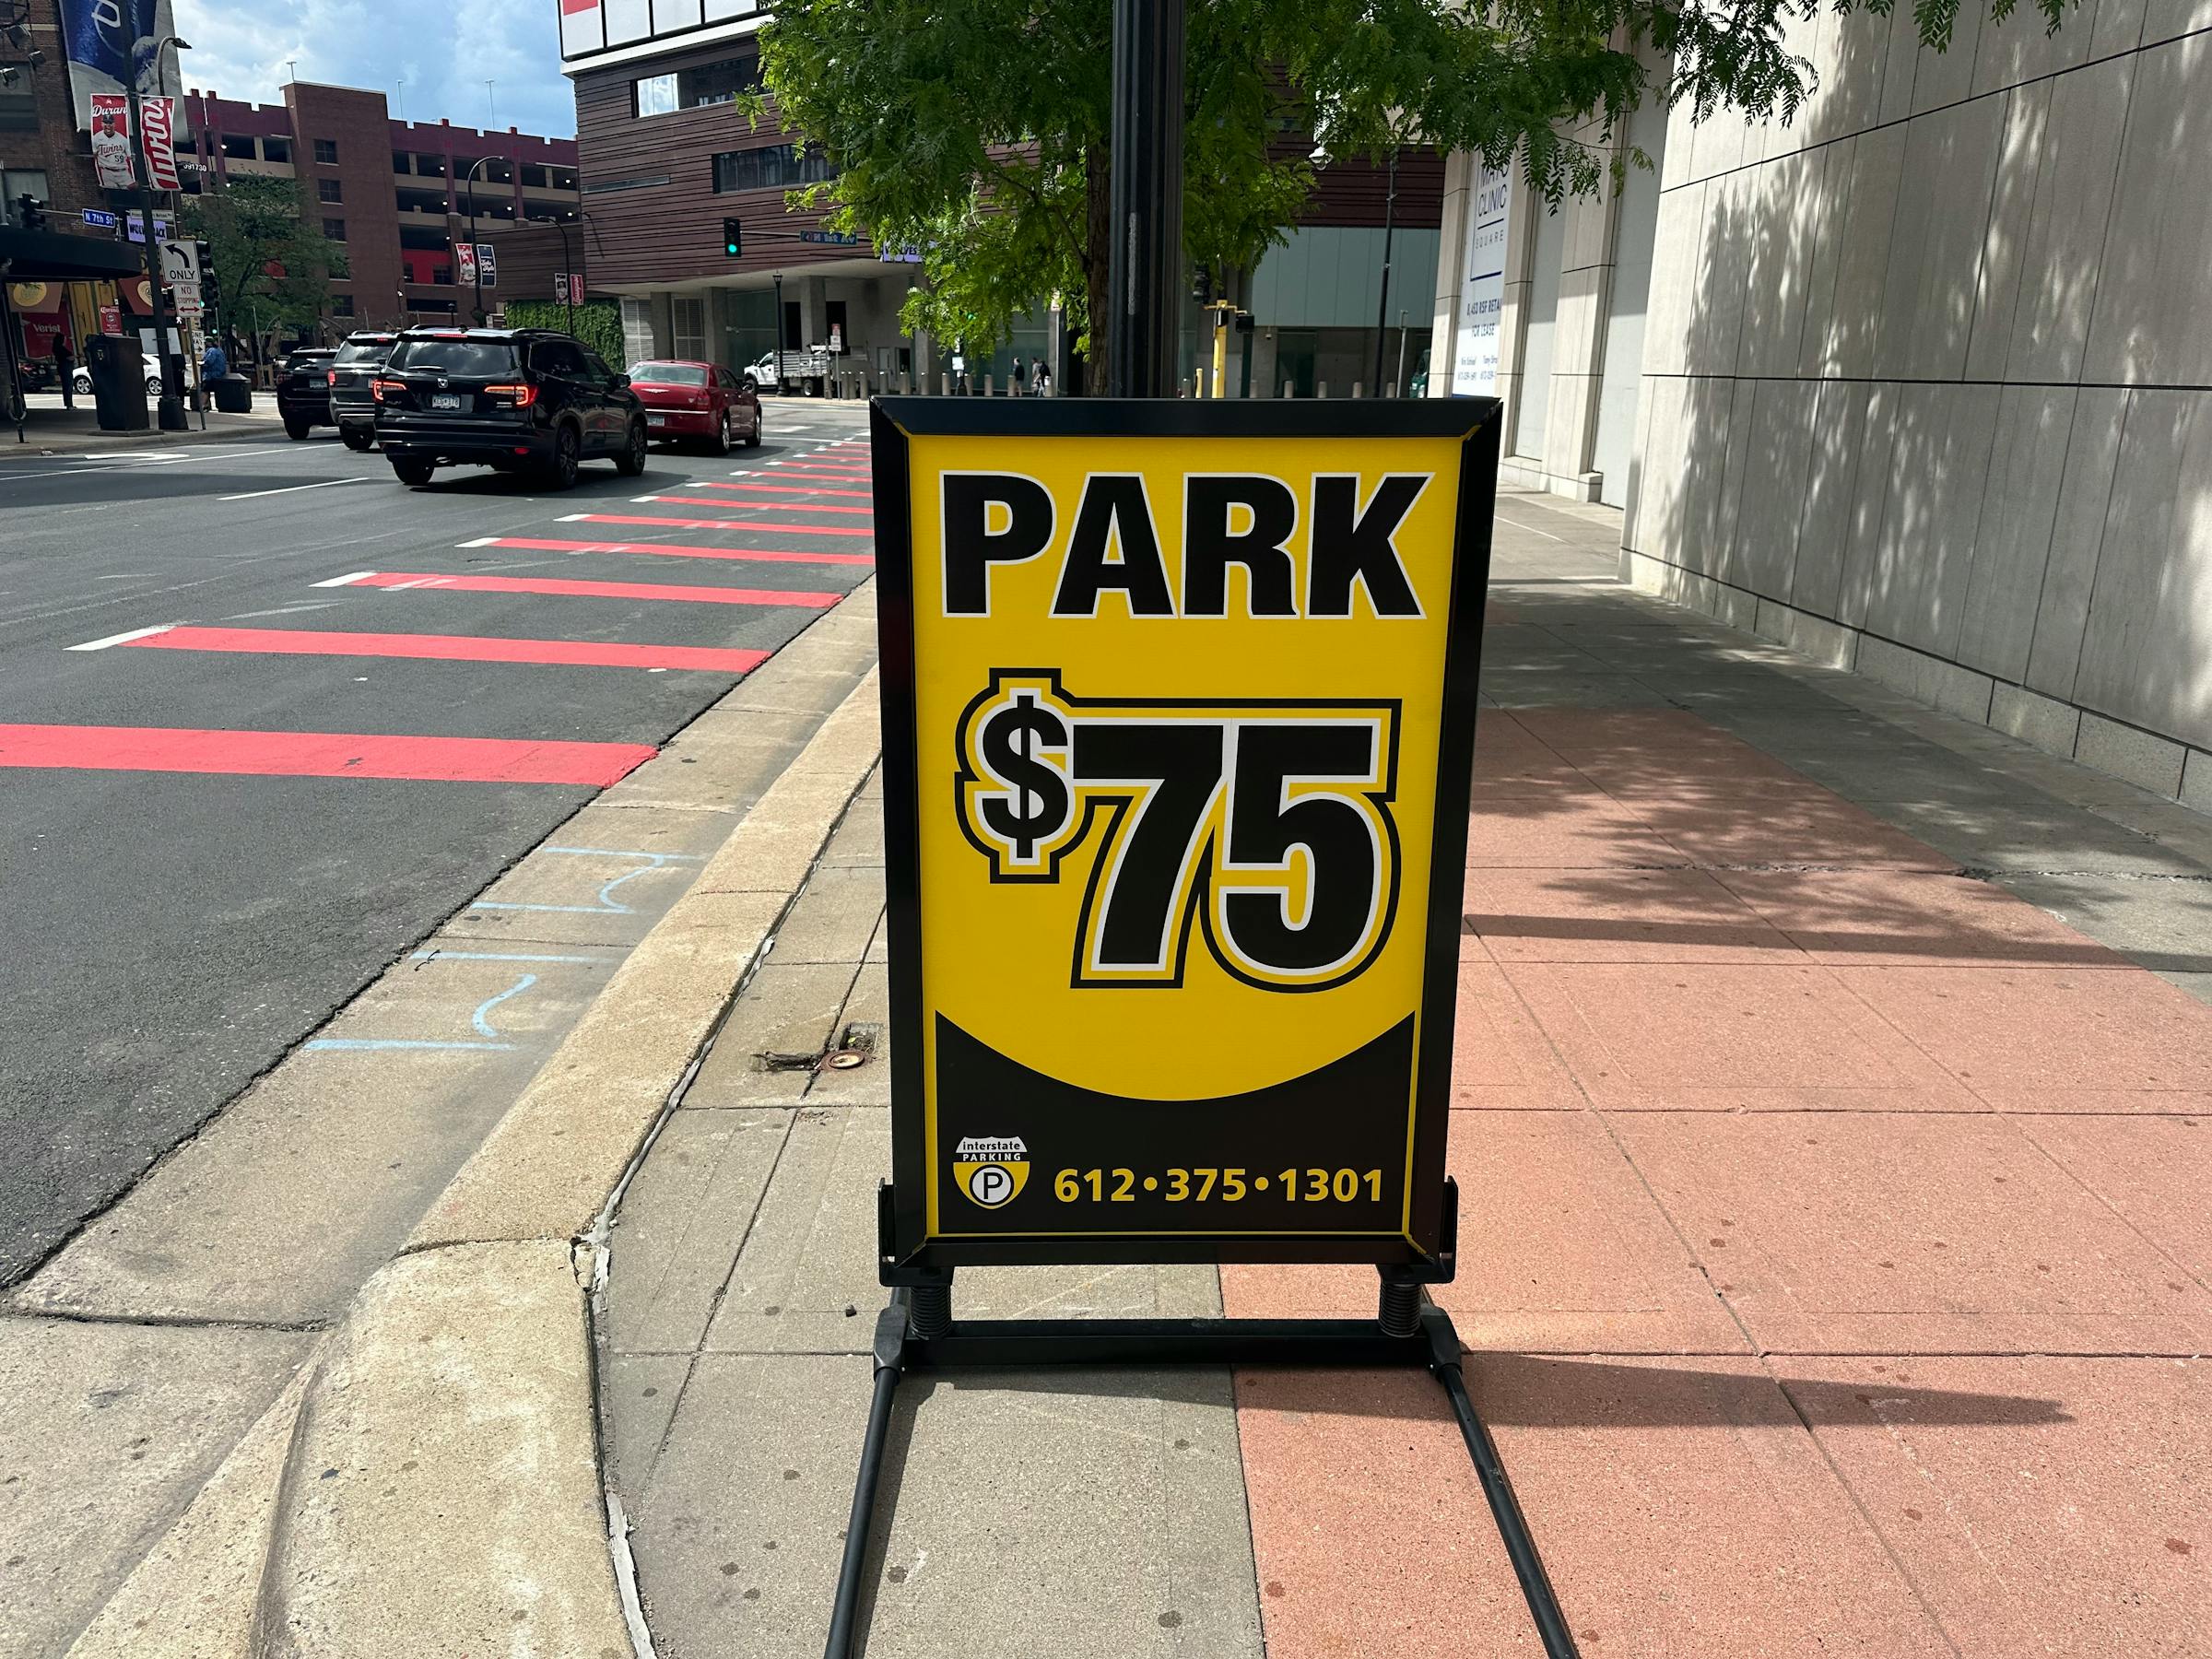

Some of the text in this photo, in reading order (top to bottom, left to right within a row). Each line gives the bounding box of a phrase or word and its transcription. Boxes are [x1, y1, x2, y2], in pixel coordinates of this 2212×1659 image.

[1477, 183, 1508, 218] CLINIC
[85, 213, 113, 226] N 7th St
[1475, 229, 1504, 250] SQUARE
[170, 270, 195, 280] ONLY
[181, 287, 192, 295] NO
[938, 469, 1437, 620] PARK
[974, 687, 1382, 976] $75
[962, 1140, 1021, 1151] interstate
[962, 1152, 1022, 1162] PARKING
[982, 1171, 1004, 1200] P
